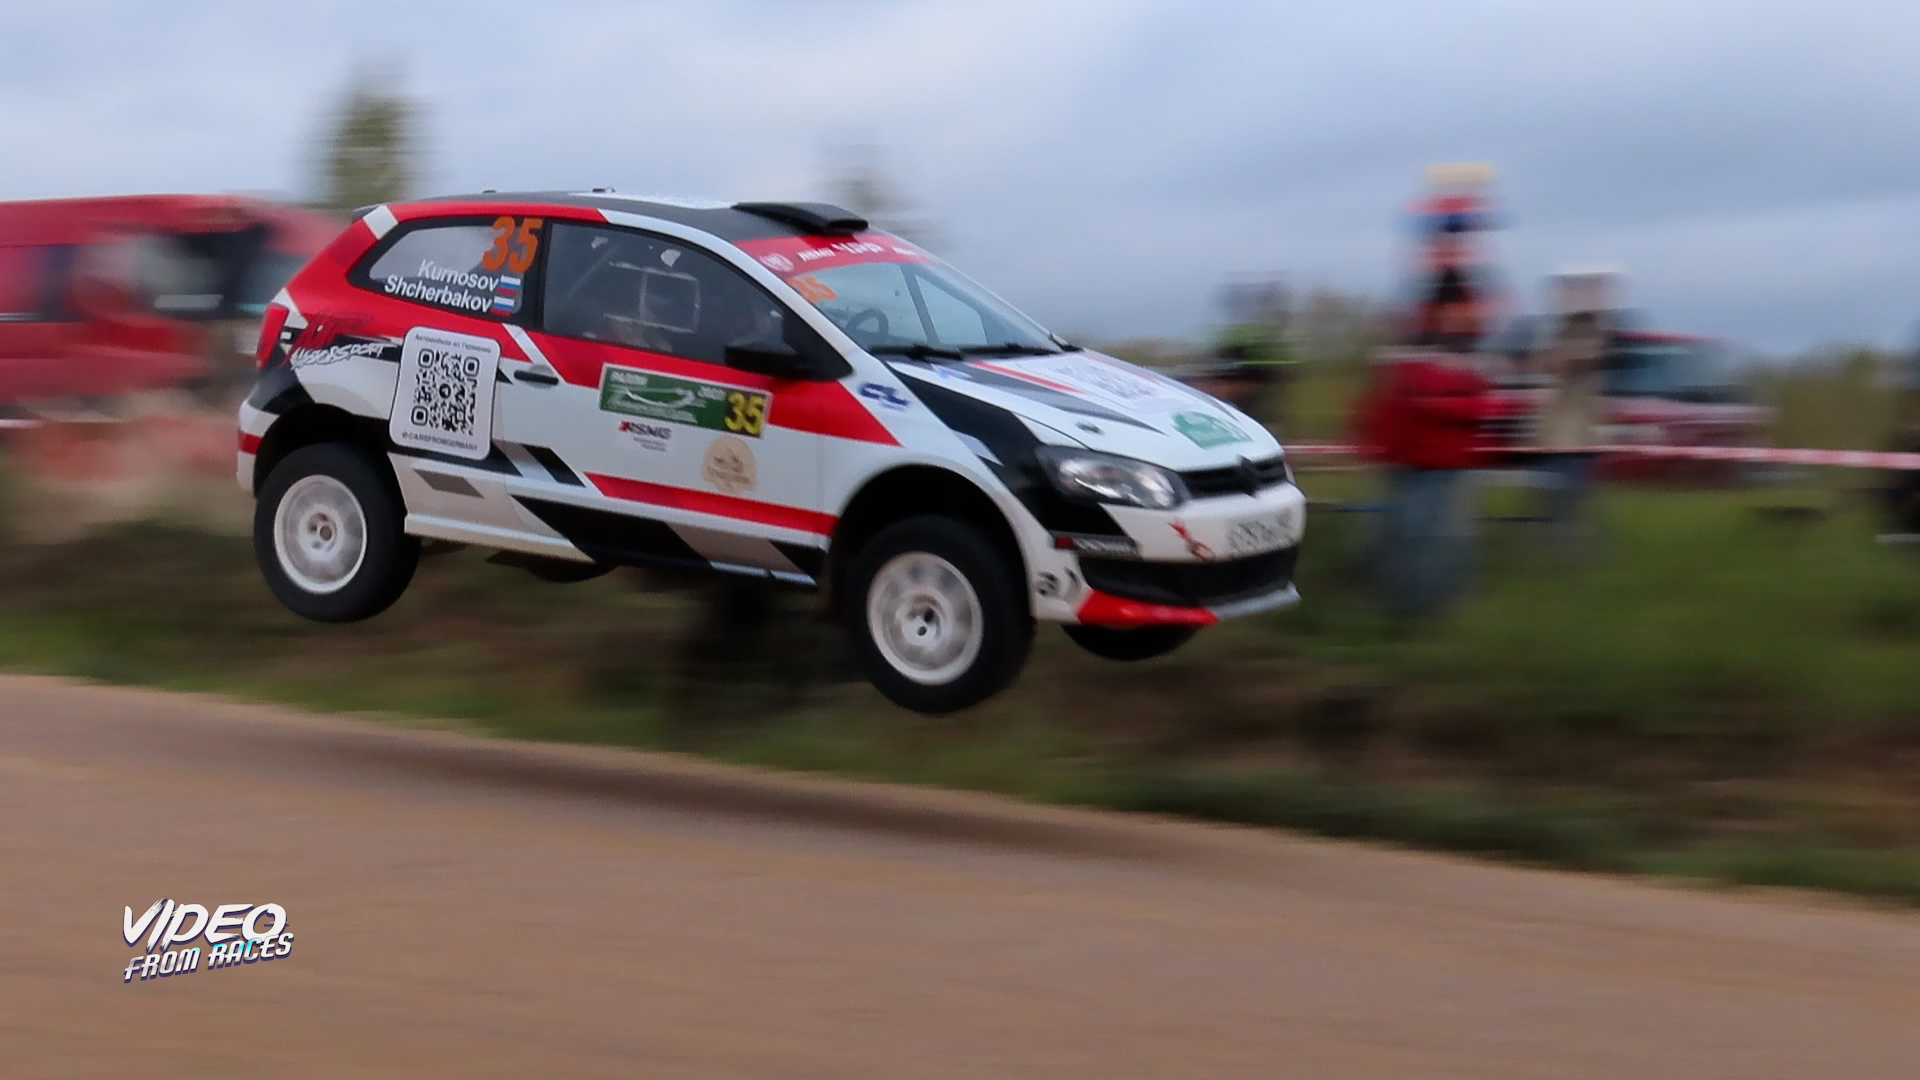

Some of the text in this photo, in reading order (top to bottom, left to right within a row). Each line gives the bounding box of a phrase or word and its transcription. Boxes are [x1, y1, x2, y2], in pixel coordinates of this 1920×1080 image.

[481, 215, 544, 274] 35
[384, 274, 493, 313] Shcherbakov
[418, 259, 499, 292] Kurnosov
[724, 392, 766, 435] 35
